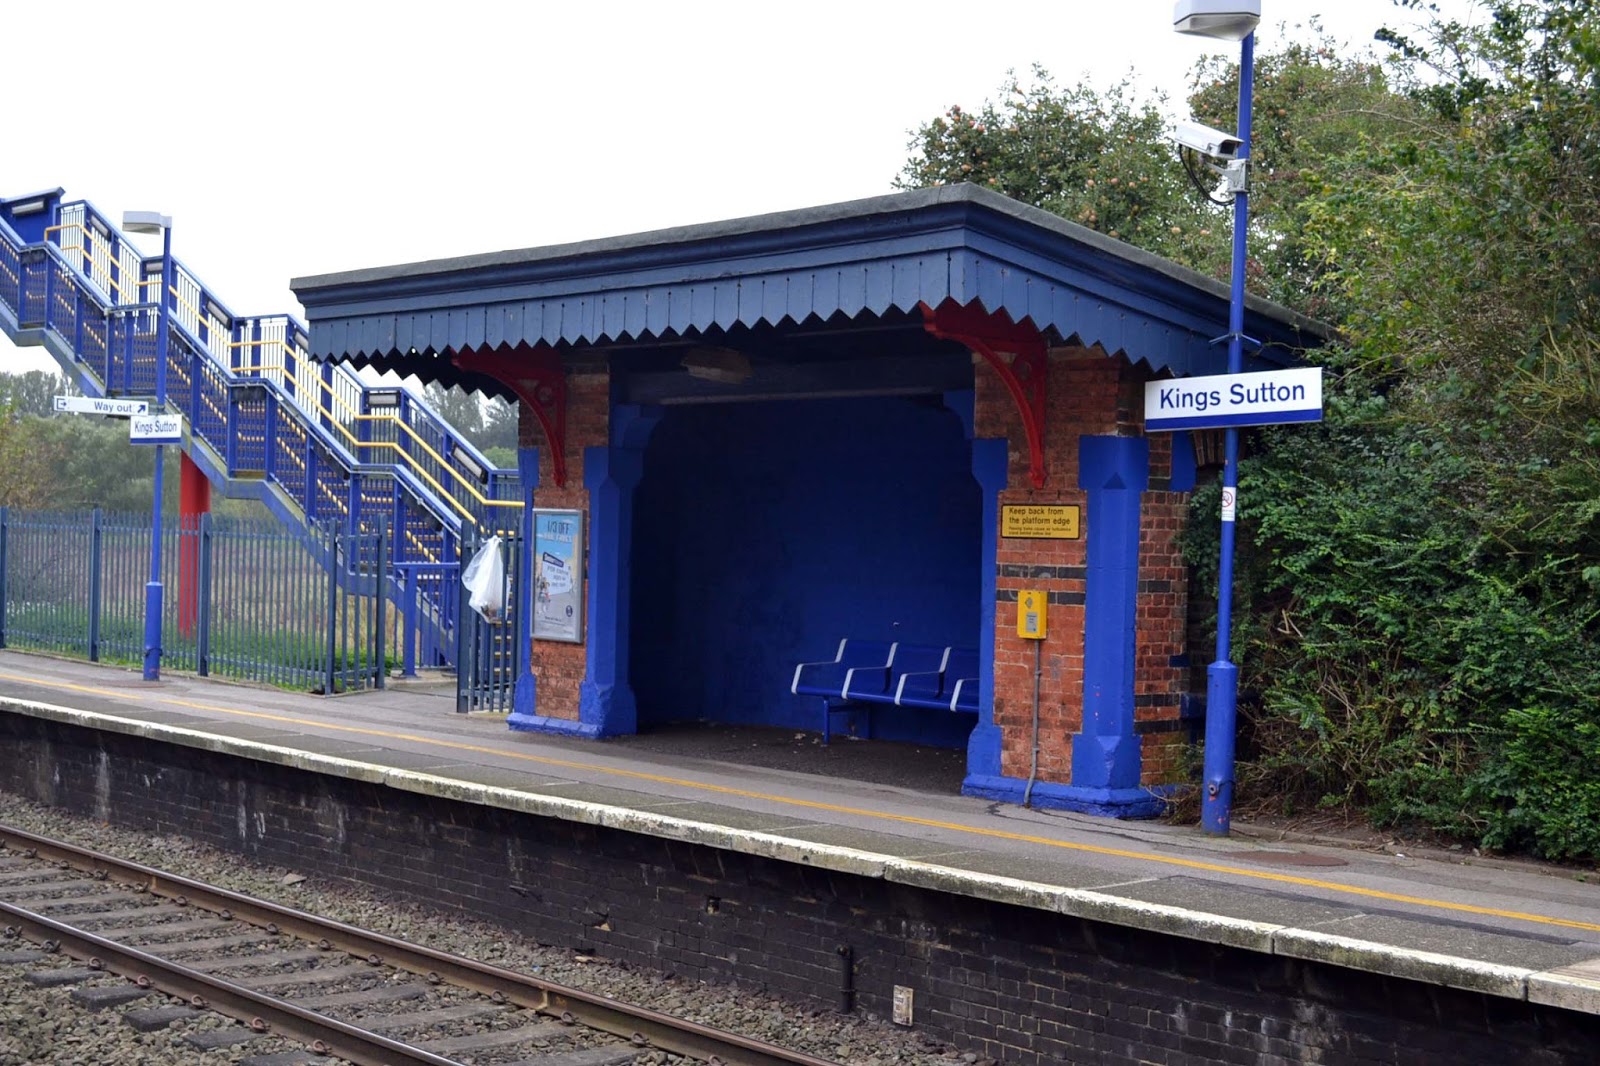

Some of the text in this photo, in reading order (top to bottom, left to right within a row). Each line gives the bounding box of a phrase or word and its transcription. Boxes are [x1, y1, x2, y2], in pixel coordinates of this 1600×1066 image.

[1160, 382, 1305, 411] Kings Sutton
[94, 401, 132, 413] Way out
[134, 420, 177, 435] Kings Sutton
[1008, 507, 1064, 515] Keep back from
[1009, 516, 1071, 526] the platform edge
